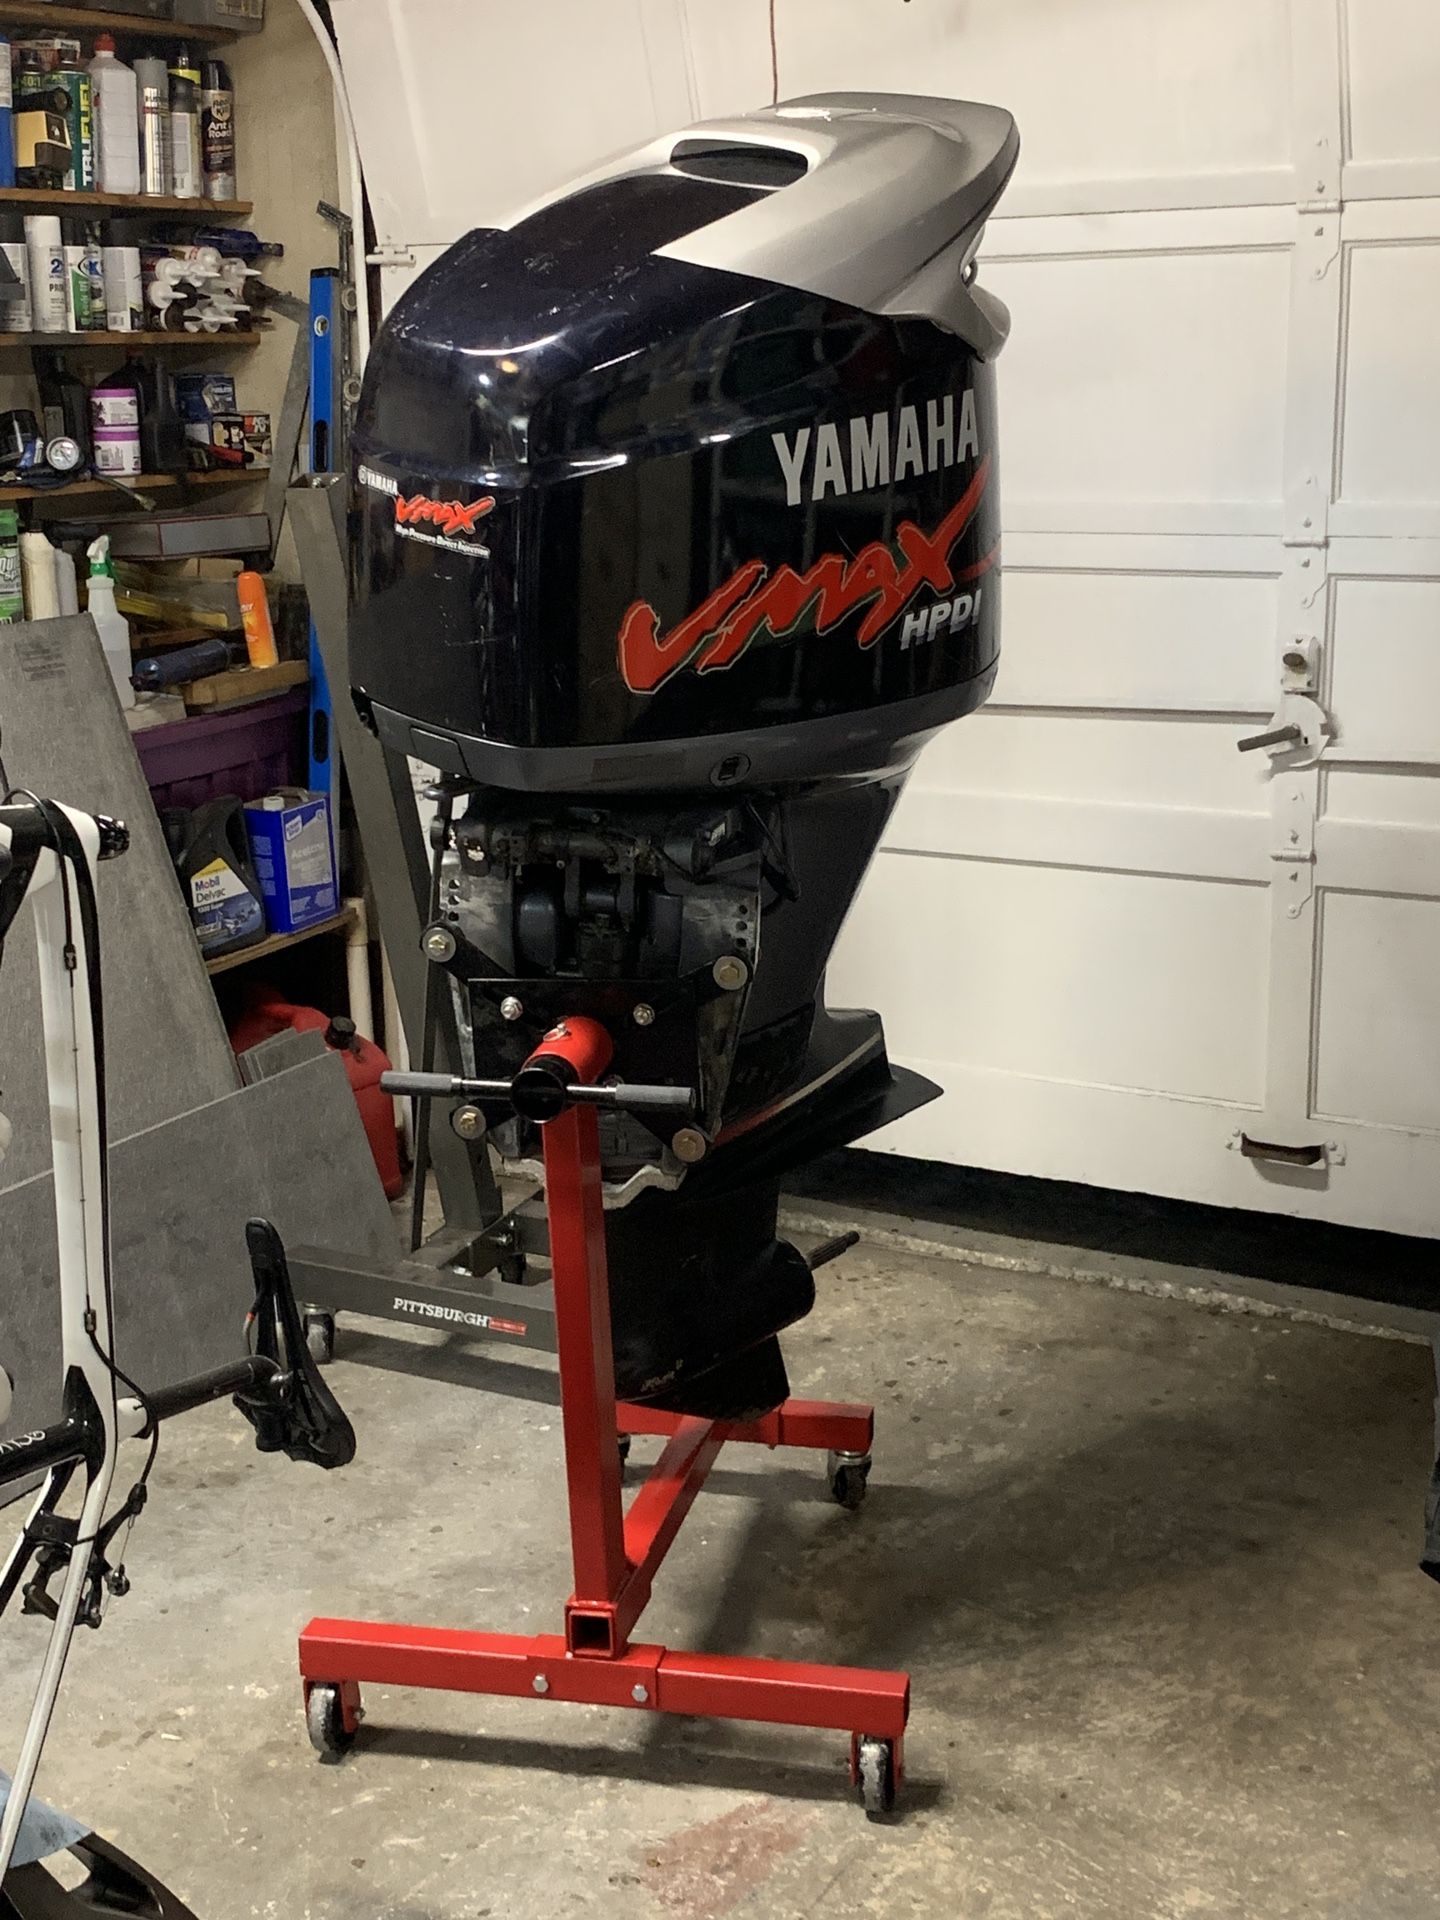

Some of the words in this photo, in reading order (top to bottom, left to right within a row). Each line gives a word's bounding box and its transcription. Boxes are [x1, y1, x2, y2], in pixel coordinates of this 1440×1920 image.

[80, 76, 93, 187] TRUFUEL
[208, 121, 227, 132] Ant
[771, 388, 979, 507] YAMAHA
[367, 472, 399, 496] YAMAHA
[900, 590, 982, 650] HPDI
[194, 875, 220, 891] Mobil
[195, 887, 226, 903] Delvac
[393, 1297, 490, 1328] PITTSBURGH
